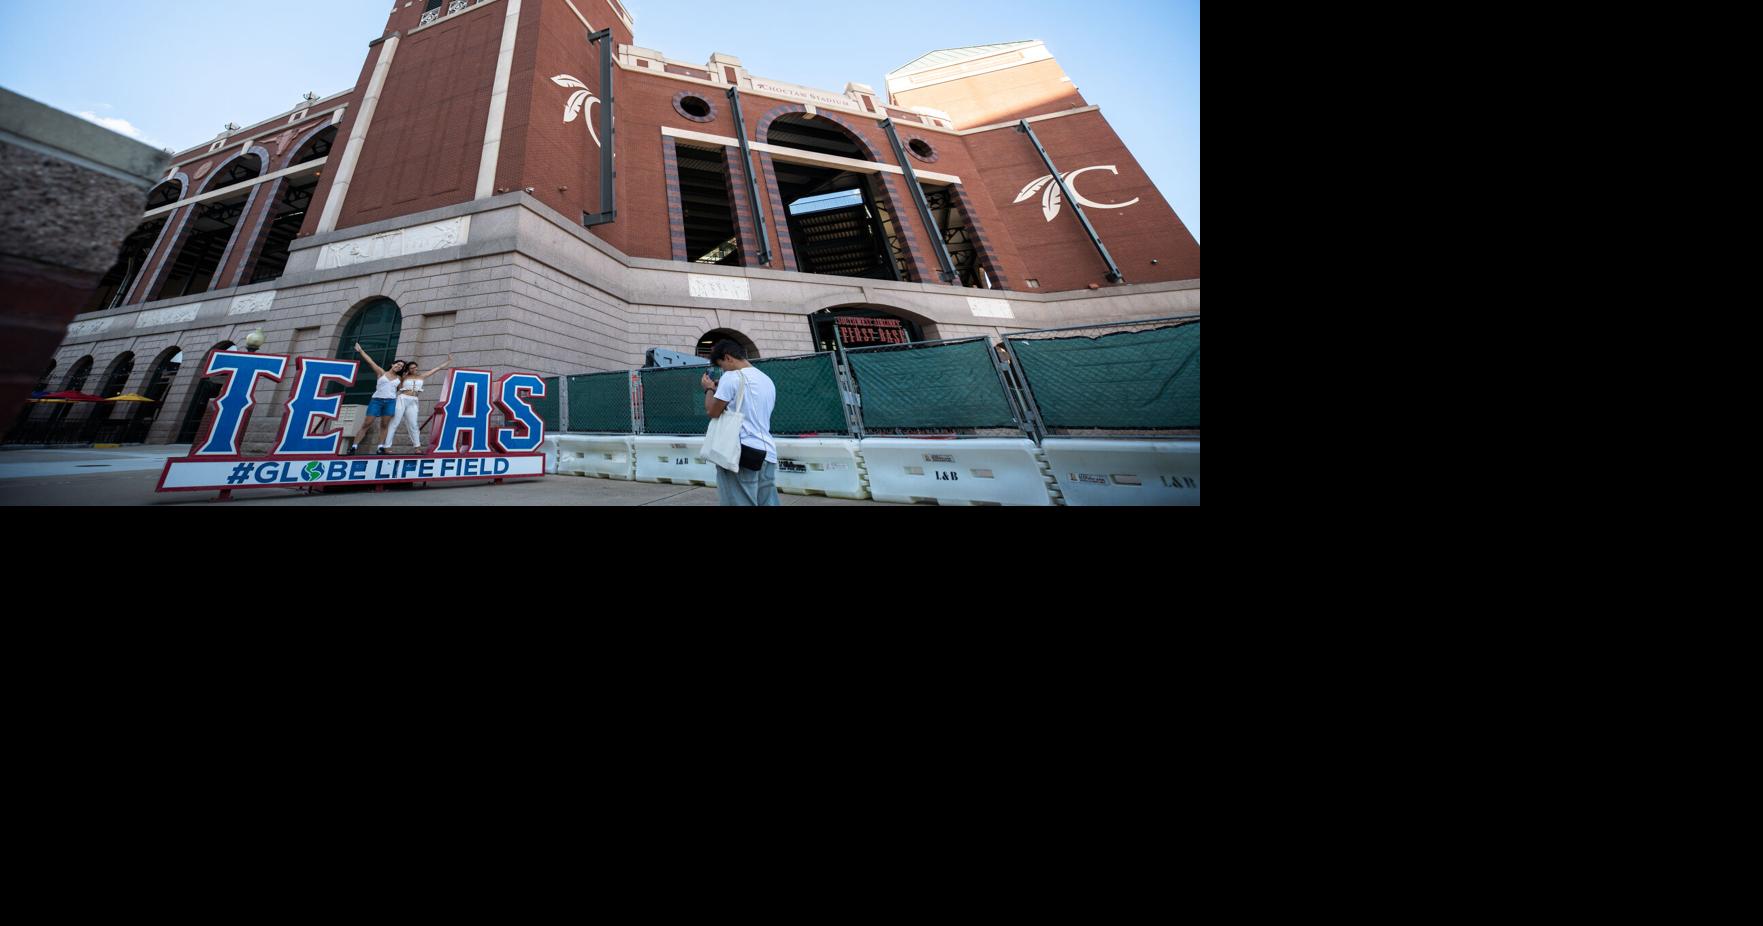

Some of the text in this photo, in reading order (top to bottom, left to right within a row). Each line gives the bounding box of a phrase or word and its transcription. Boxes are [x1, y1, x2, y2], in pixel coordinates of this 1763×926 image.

[840, 326, 908, 345] FIRST BASE
[374, 458, 434, 479] LIFE
[439, 457, 510, 477] FIELD
[935, 470, 959, 481] L&B
